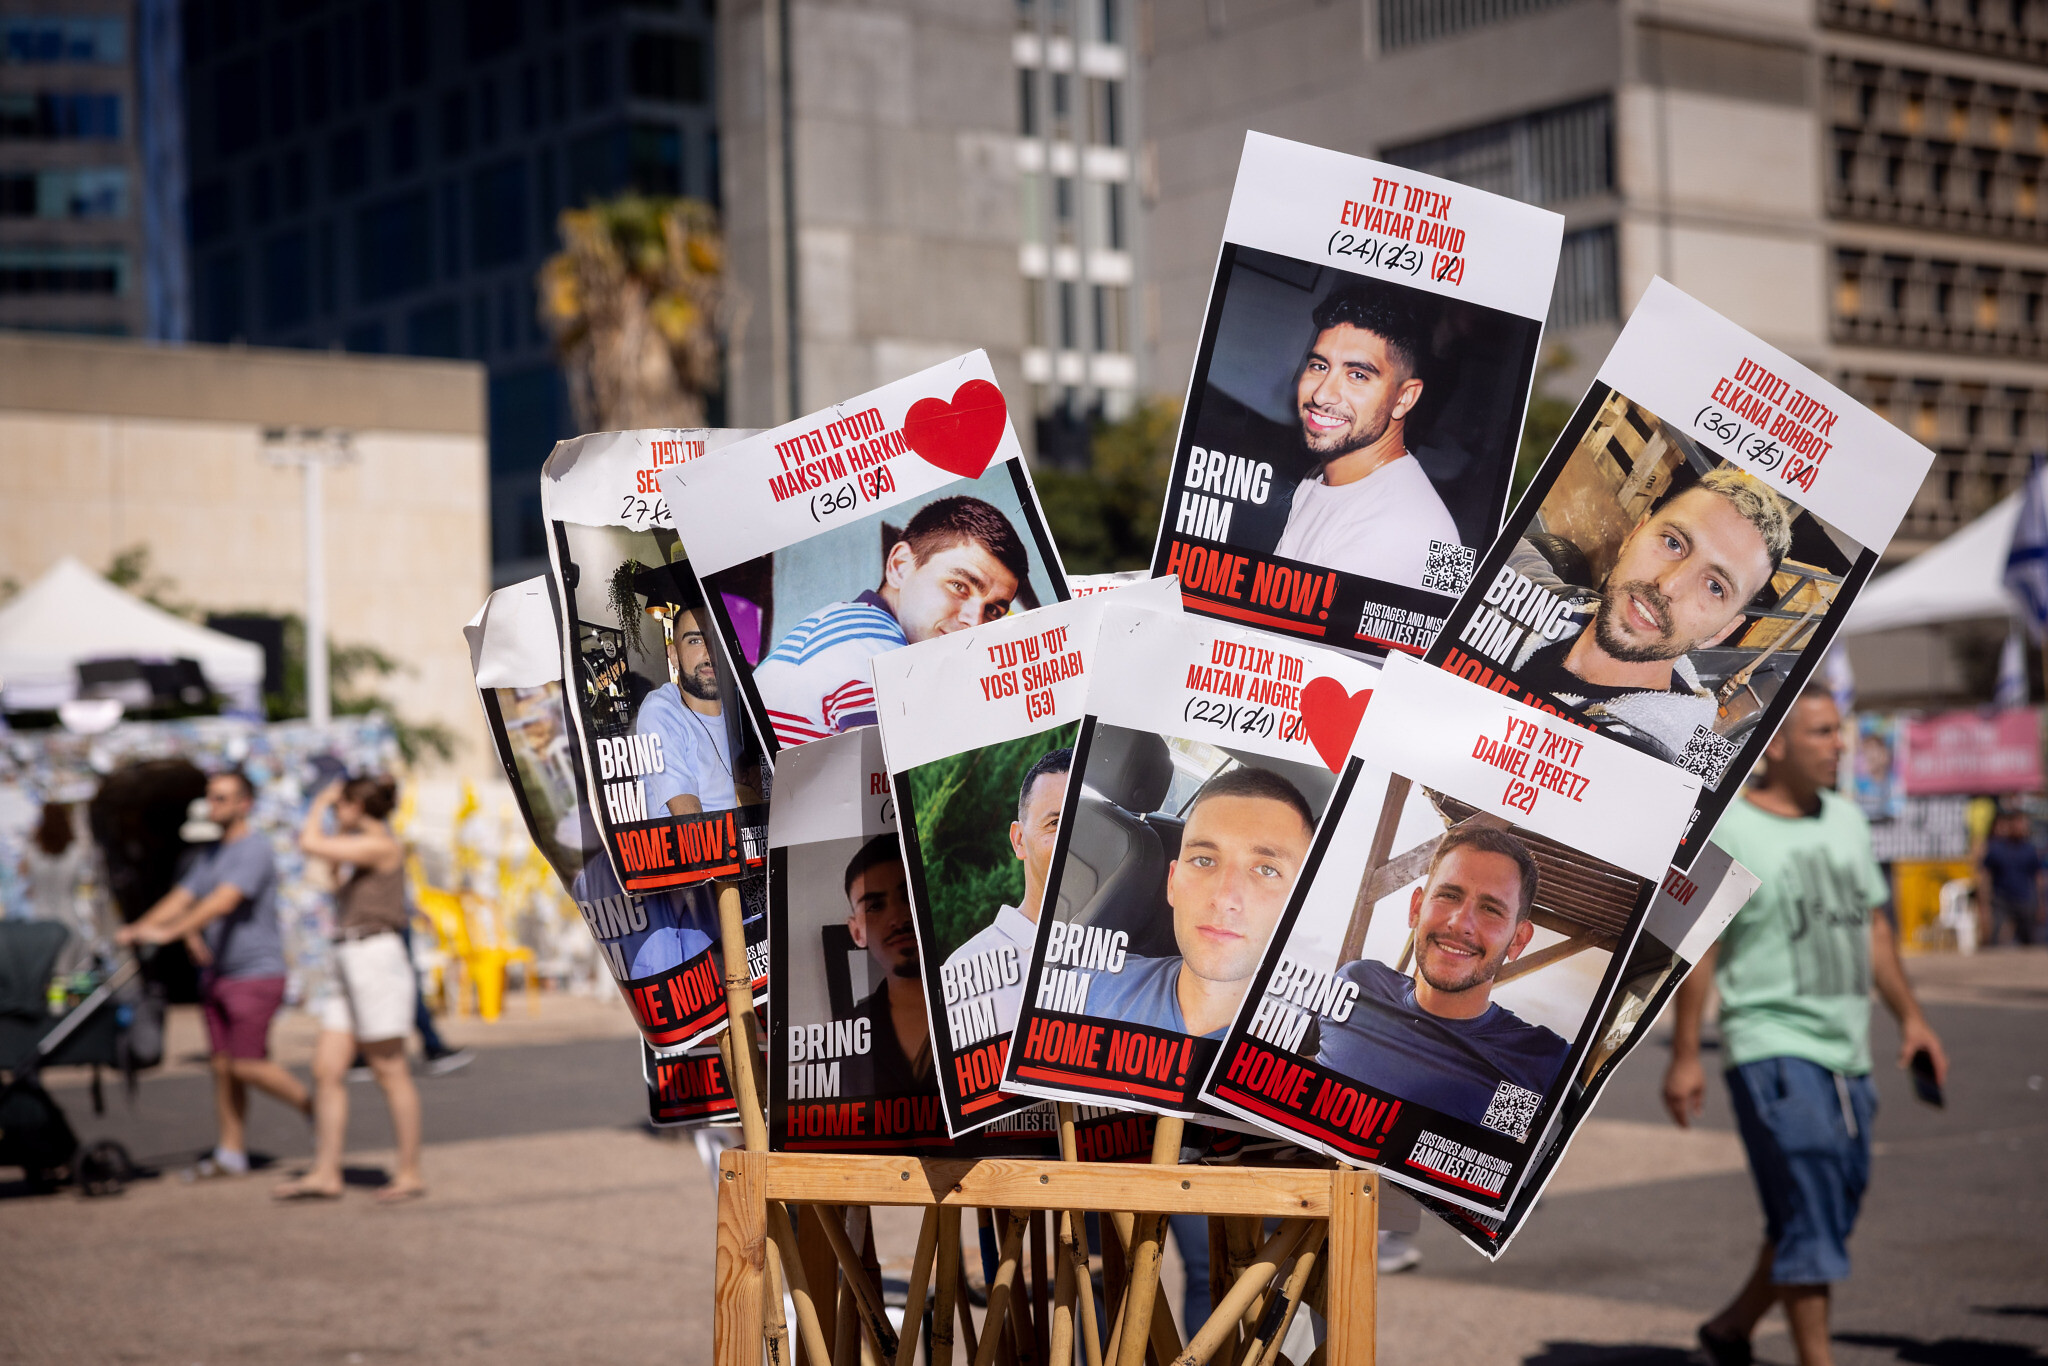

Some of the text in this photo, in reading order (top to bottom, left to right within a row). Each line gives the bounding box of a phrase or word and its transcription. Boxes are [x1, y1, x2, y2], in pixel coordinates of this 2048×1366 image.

[1372, 177, 1452, 221] אביתר דוד
[1340, 200, 1466, 253] EVYATAR DAVID
[1431, 251, 1465, 286] (22)
[1711, 377, 1833, 465] ELKANA BOHBOT
[1734, 357, 1839, 437] אלקנה בוחבוט
[768, 427, 912, 502] MAKSYM HARKIN
[774, 407, 885, 471] מקסים הרקין
[811, 464, 896, 522] (36) (35)
[1184, 445, 1273, 505] BRING
[1175, 490, 1234, 543] HIM
[1165, 540, 1340, 620] HOME NOW!
[1483, 564, 1574, 640] BRING
[1357, 615, 1414, 646] FAMILIES
[1362, 600, 1407, 623] HOSTAGES
[1405, 611, 1425, 628] AND
[1458, 604, 1524, 665] HIM
[988, 625, 1068, 670] יוסי שרעבי
[1211, 639, 1304, 683] מתן אנגרסט
[980, 650, 1085, 701] YOSI SHARABI
[1185, 664, 1246, 699] MATAN
[1025, 687, 1056, 723] (53)
[596, 732, 664, 780] BRING
[1503, 715, 1585, 768] דניאל פרץ
[1471, 734, 1591, 803] DANIEL PERETZ
[604, 780, 648, 824] HIM
[1501, 778, 1539, 815] (22)
[615, 812, 738, 872] HOME NOW!
[1043, 920, 1129, 974] BRING
[667, 950, 724, 1020] NOW!
[939, 944, 1020, 1005] BRING
[1034, 967, 1091, 1016] HIM
[1267, 955, 1360, 1023] BRING
[788, 1016, 872, 1062] BRING
[946, 997, 999, 1052] HIM
[1247, 998, 1312, 1054] HIM
[1023, 1016, 1197, 1087] HOME NOW!
[657, 1057, 724, 1102] HOME
[788, 1062, 840, 1100] HIM
[1226, 1041, 1404, 1145] HOME NOW!
[787, 1102, 865, 1137] HOME
[984, 1112, 1040, 1133] FAMILIES
[1075, 1115, 1154, 1161] HOME
[1408, 1142, 1507, 1194] FAMILIES FORUM
[1417, 1129, 1513, 1177] HOSTAGES AND MISSING
